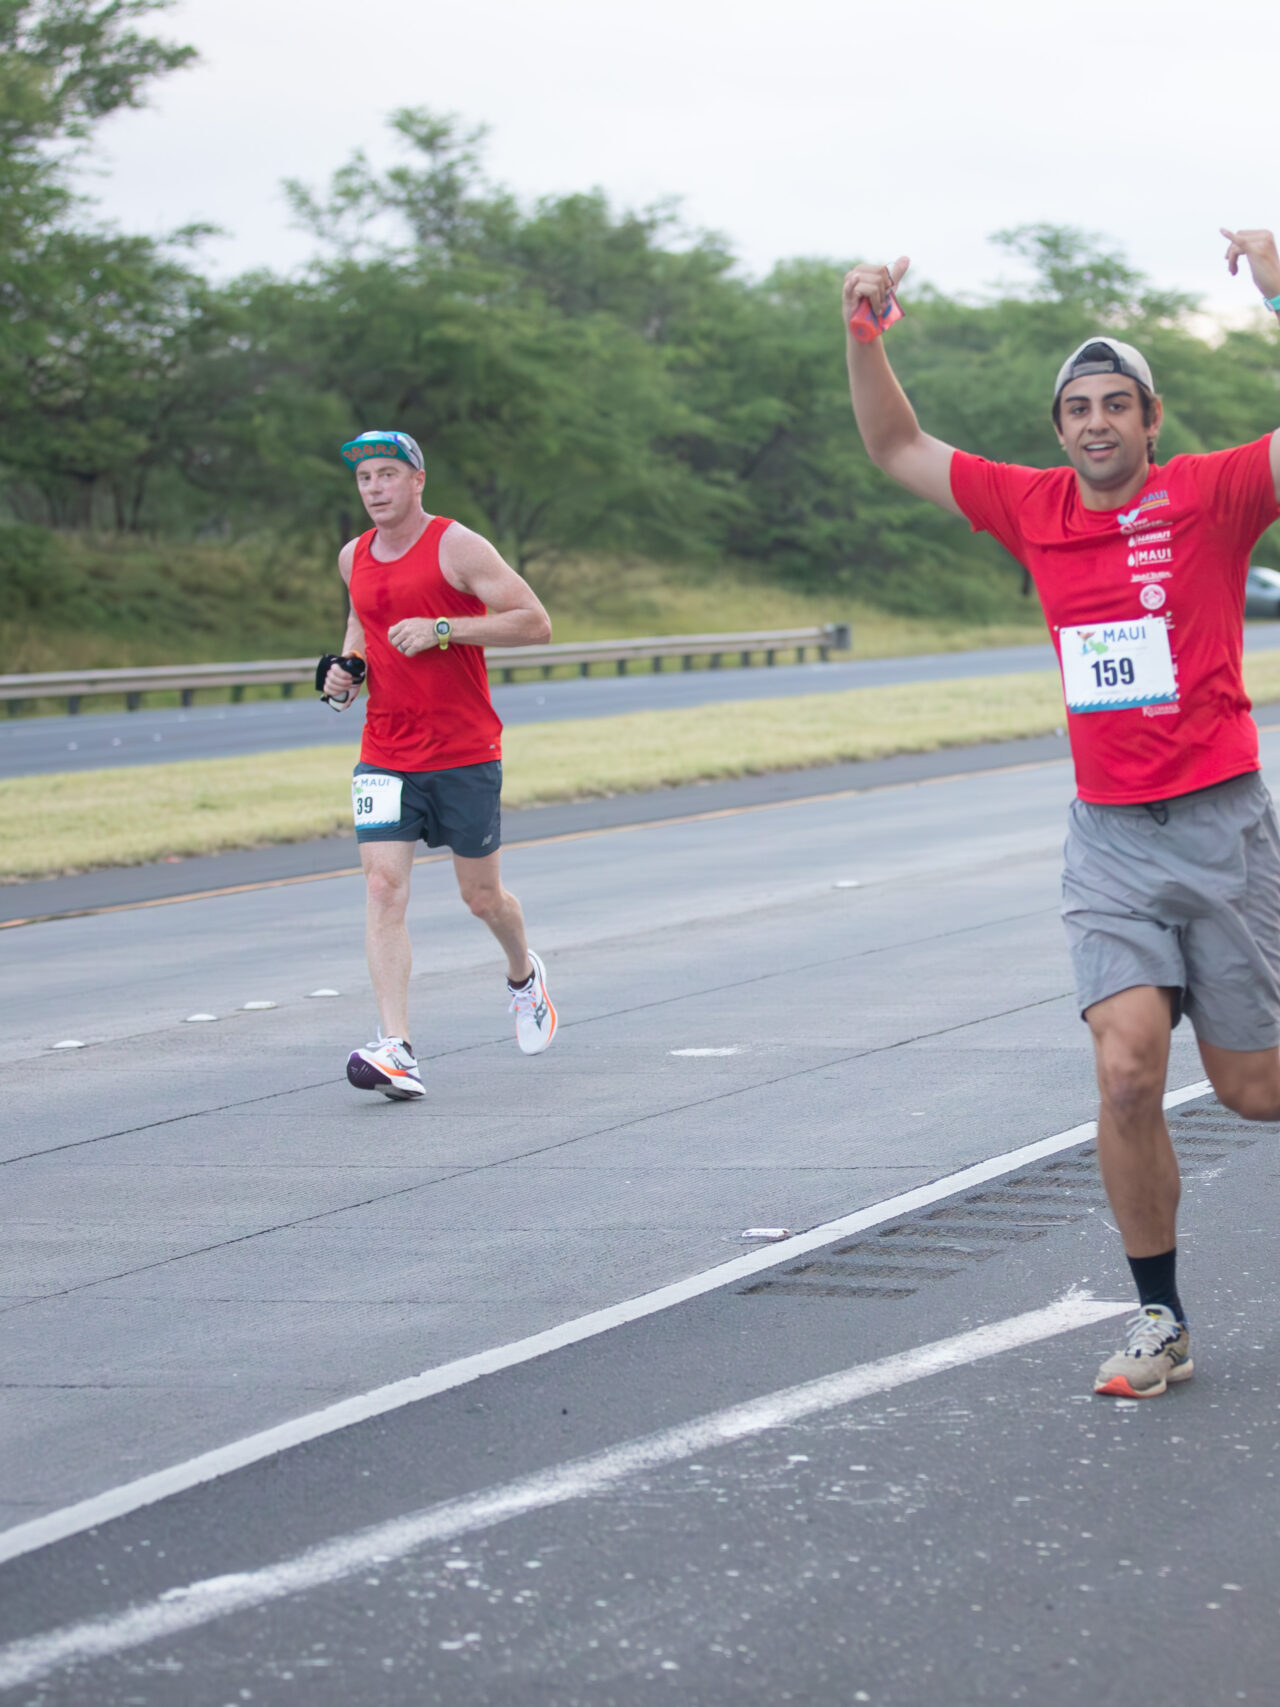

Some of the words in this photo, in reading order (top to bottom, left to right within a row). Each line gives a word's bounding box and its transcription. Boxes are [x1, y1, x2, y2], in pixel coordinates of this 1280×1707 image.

[1139, 548, 1171, 561] MAUI
[1103, 625, 1146, 643] MAUI
[1091, 657, 1135, 688] 159
[361, 778, 390, 787] MAUI
[357, 796, 373, 815] 39
